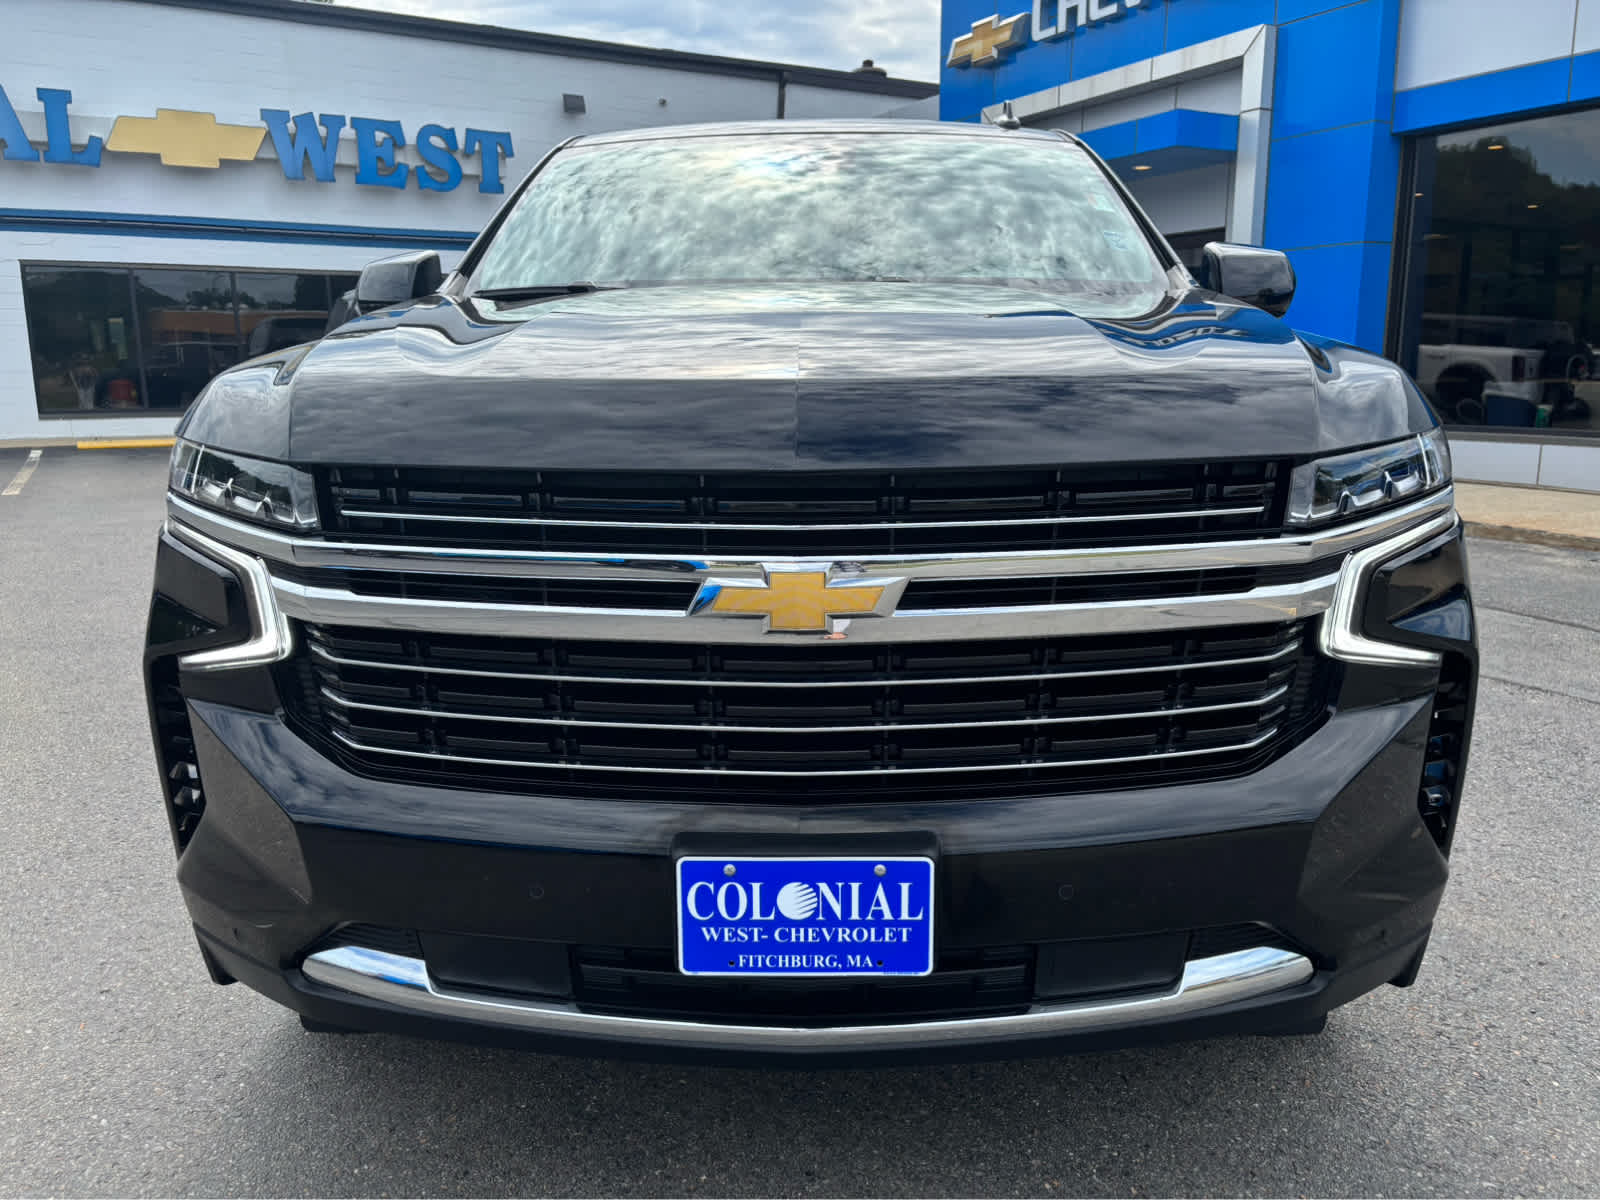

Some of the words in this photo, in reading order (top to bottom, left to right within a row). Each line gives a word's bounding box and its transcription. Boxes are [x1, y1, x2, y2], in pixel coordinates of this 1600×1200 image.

[1031, 0, 1142, 42] CH
[260, 108, 514, 194] WEST
[686, 881, 924, 921] COLONIAL
[701, 927, 769, 943] WEST-
[774, 927, 912, 943] CHEVROLET
[738, 954, 842, 969] FITCHBURG,
[846, 954, 874, 968] MA
